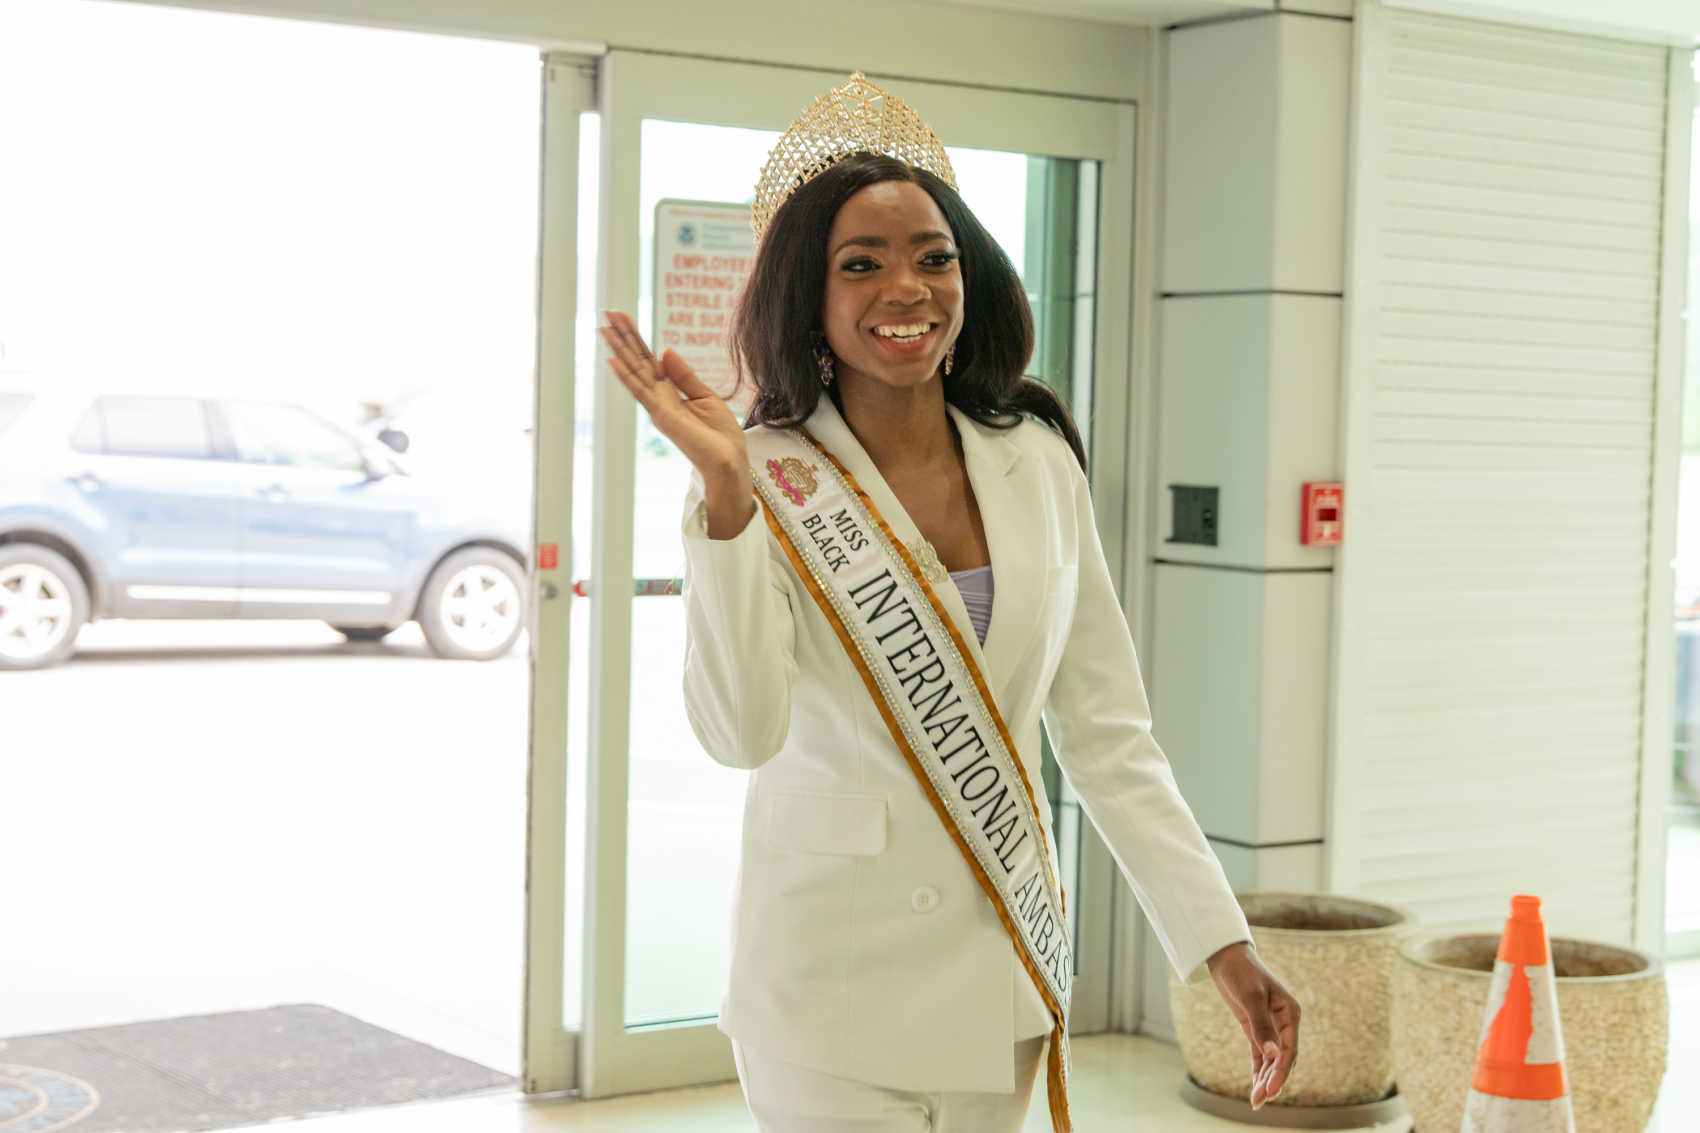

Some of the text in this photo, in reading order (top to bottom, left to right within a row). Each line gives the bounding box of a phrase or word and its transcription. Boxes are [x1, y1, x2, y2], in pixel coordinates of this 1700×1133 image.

[664, 271, 734, 291] ENTERING
[665, 292, 721, 310] STERILE
[667, 310, 694, 328] ARE
[662, 329, 680, 346] TO
[829, 508, 869, 552] MISS
[802, 513, 850, 573] BLACK
[847, 567, 1070, 1004] INTERNATIONAL AMBAS
